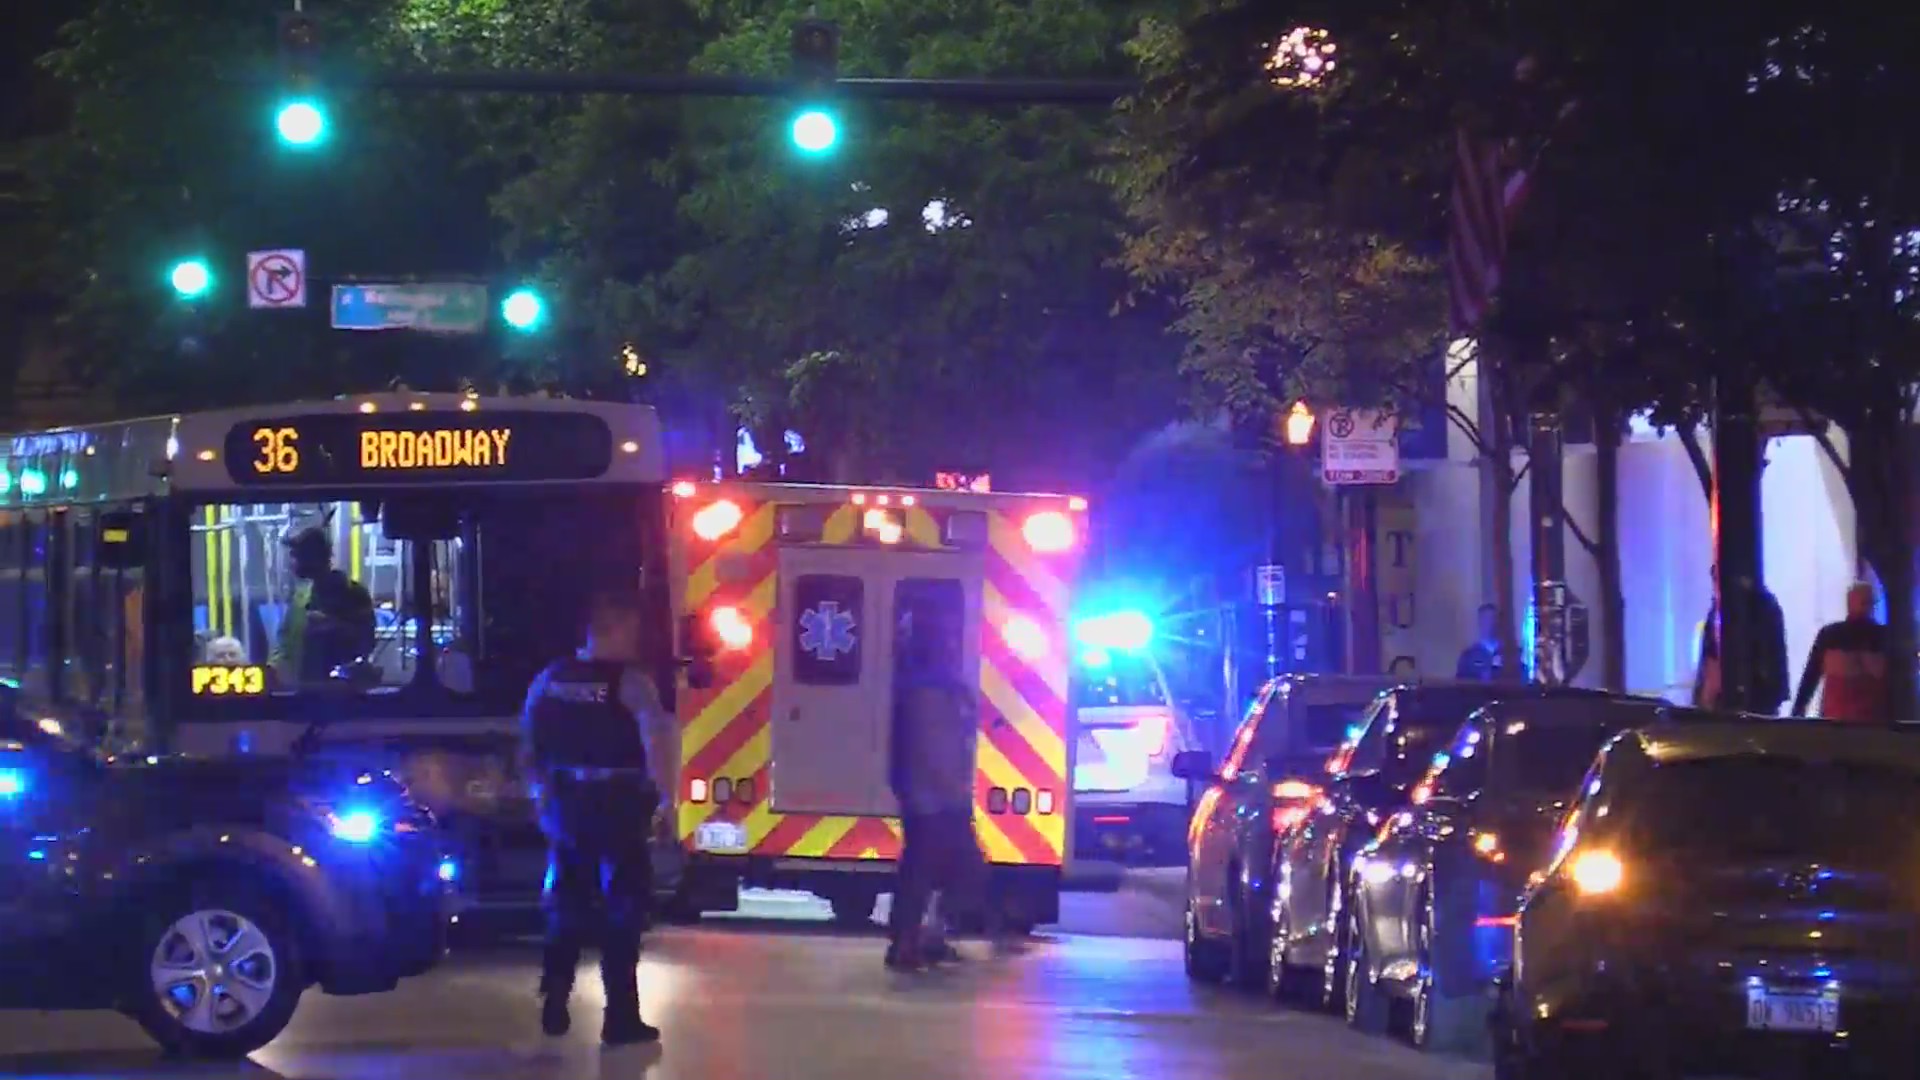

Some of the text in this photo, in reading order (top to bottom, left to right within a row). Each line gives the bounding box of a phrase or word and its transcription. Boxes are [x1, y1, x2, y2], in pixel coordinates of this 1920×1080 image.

[253, 427, 511, 473] 36 BROADWAY
[191, 666, 264, 695] P343
